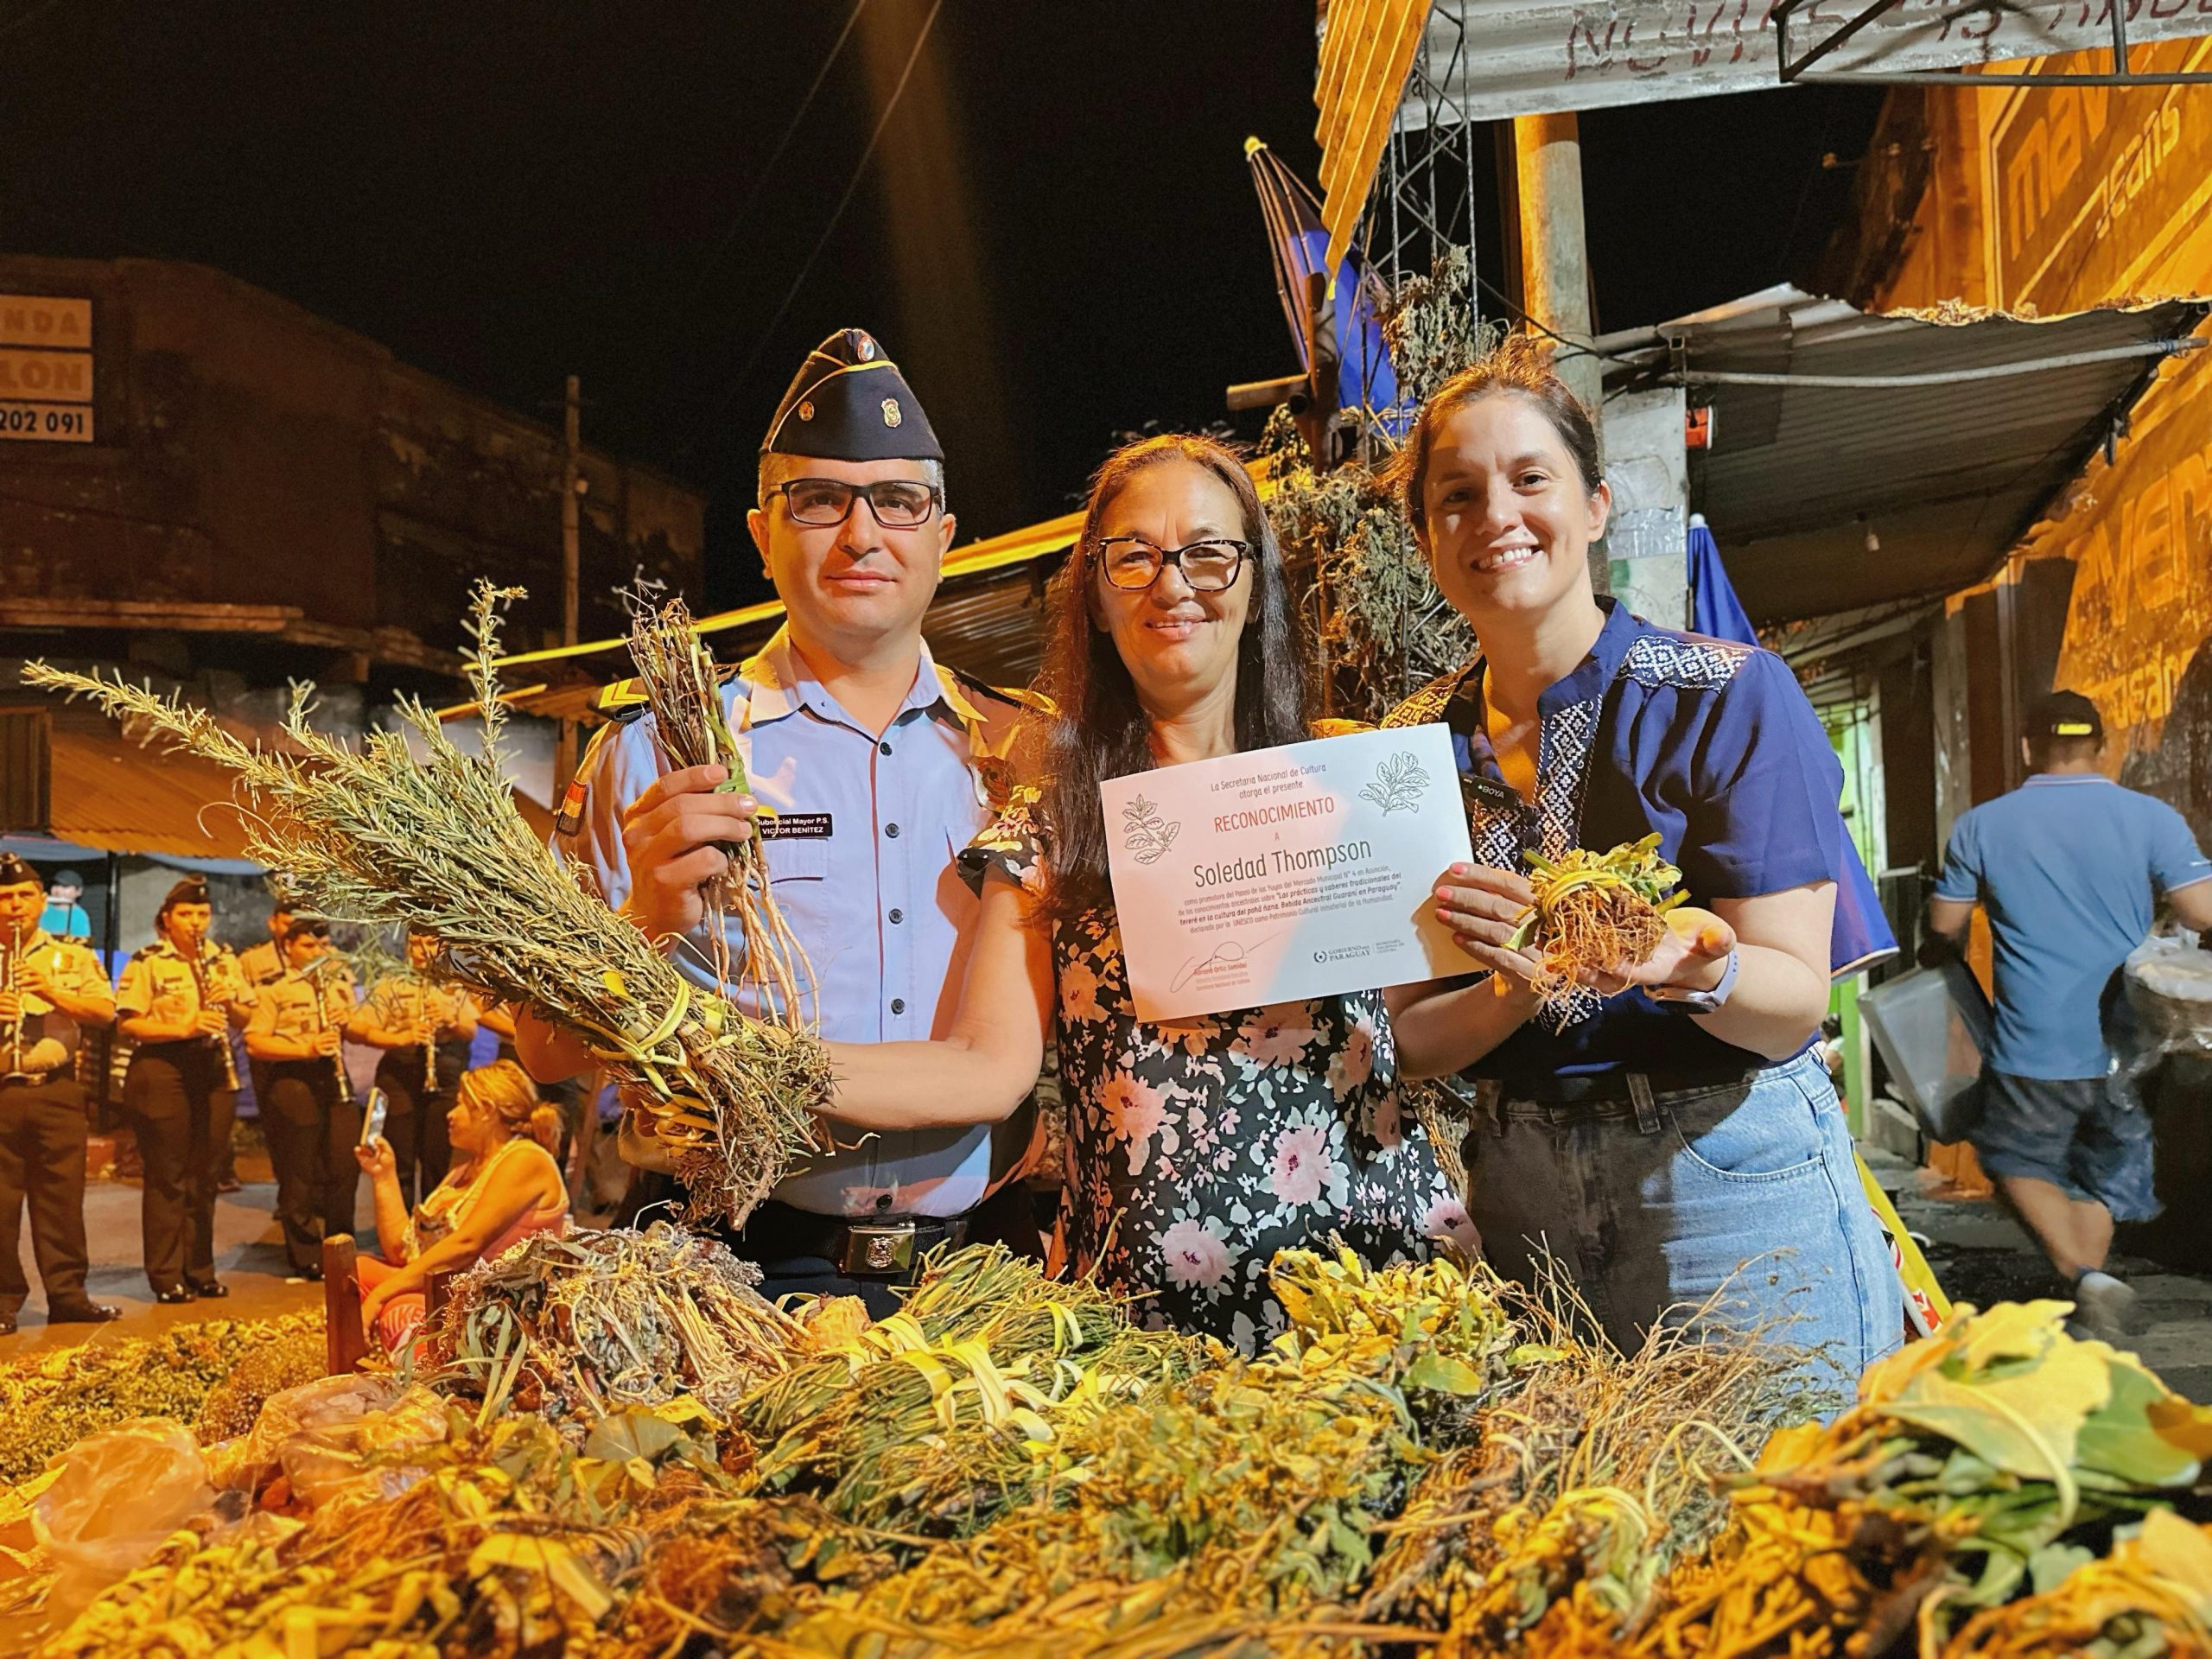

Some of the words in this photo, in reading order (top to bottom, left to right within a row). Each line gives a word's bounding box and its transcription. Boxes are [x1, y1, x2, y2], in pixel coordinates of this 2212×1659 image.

[46, 412, 83, 434] 091
[1211, 783, 1219, 791] La
[1258, 769, 1287, 783] Nacional
[1290, 768, 1299, 778] de
[1300, 764, 1326, 775] Cultura
[1239, 788, 1262, 800] otorga
[1264, 785, 1270, 795] el
[1273, 780, 1303, 795] presente
[1482, 785, 1504, 799] BOYA
[1214, 796, 1334, 833] RECONOCIMIENTO
[1274, 832, 1280, 842] A
[1194, 853, 1267, 887] Soledad
[1272, 839, 1372, 874] Thompson
[1262, 893, 1275, 902] sobre
[1290, 886, 1318, 897] prácticas
[1325, 881, 1348, 892] saberes
[1350, 874, 1390, 887] tradicionales
[1214, 910, 1236, 919] cultura
[1236, 908, 1246, 917] del
[1281, 898, 1301, 909] Bebida
[1303, 894, 1332, 906] Ancestral
[1358, 887, 1366, 896] en
[1232, 917, 1254, 926] UNESCO
[1328, 945, 1361, 955] GOBIERNO
[1330, 950, 1370, 962] PARAGUAY
